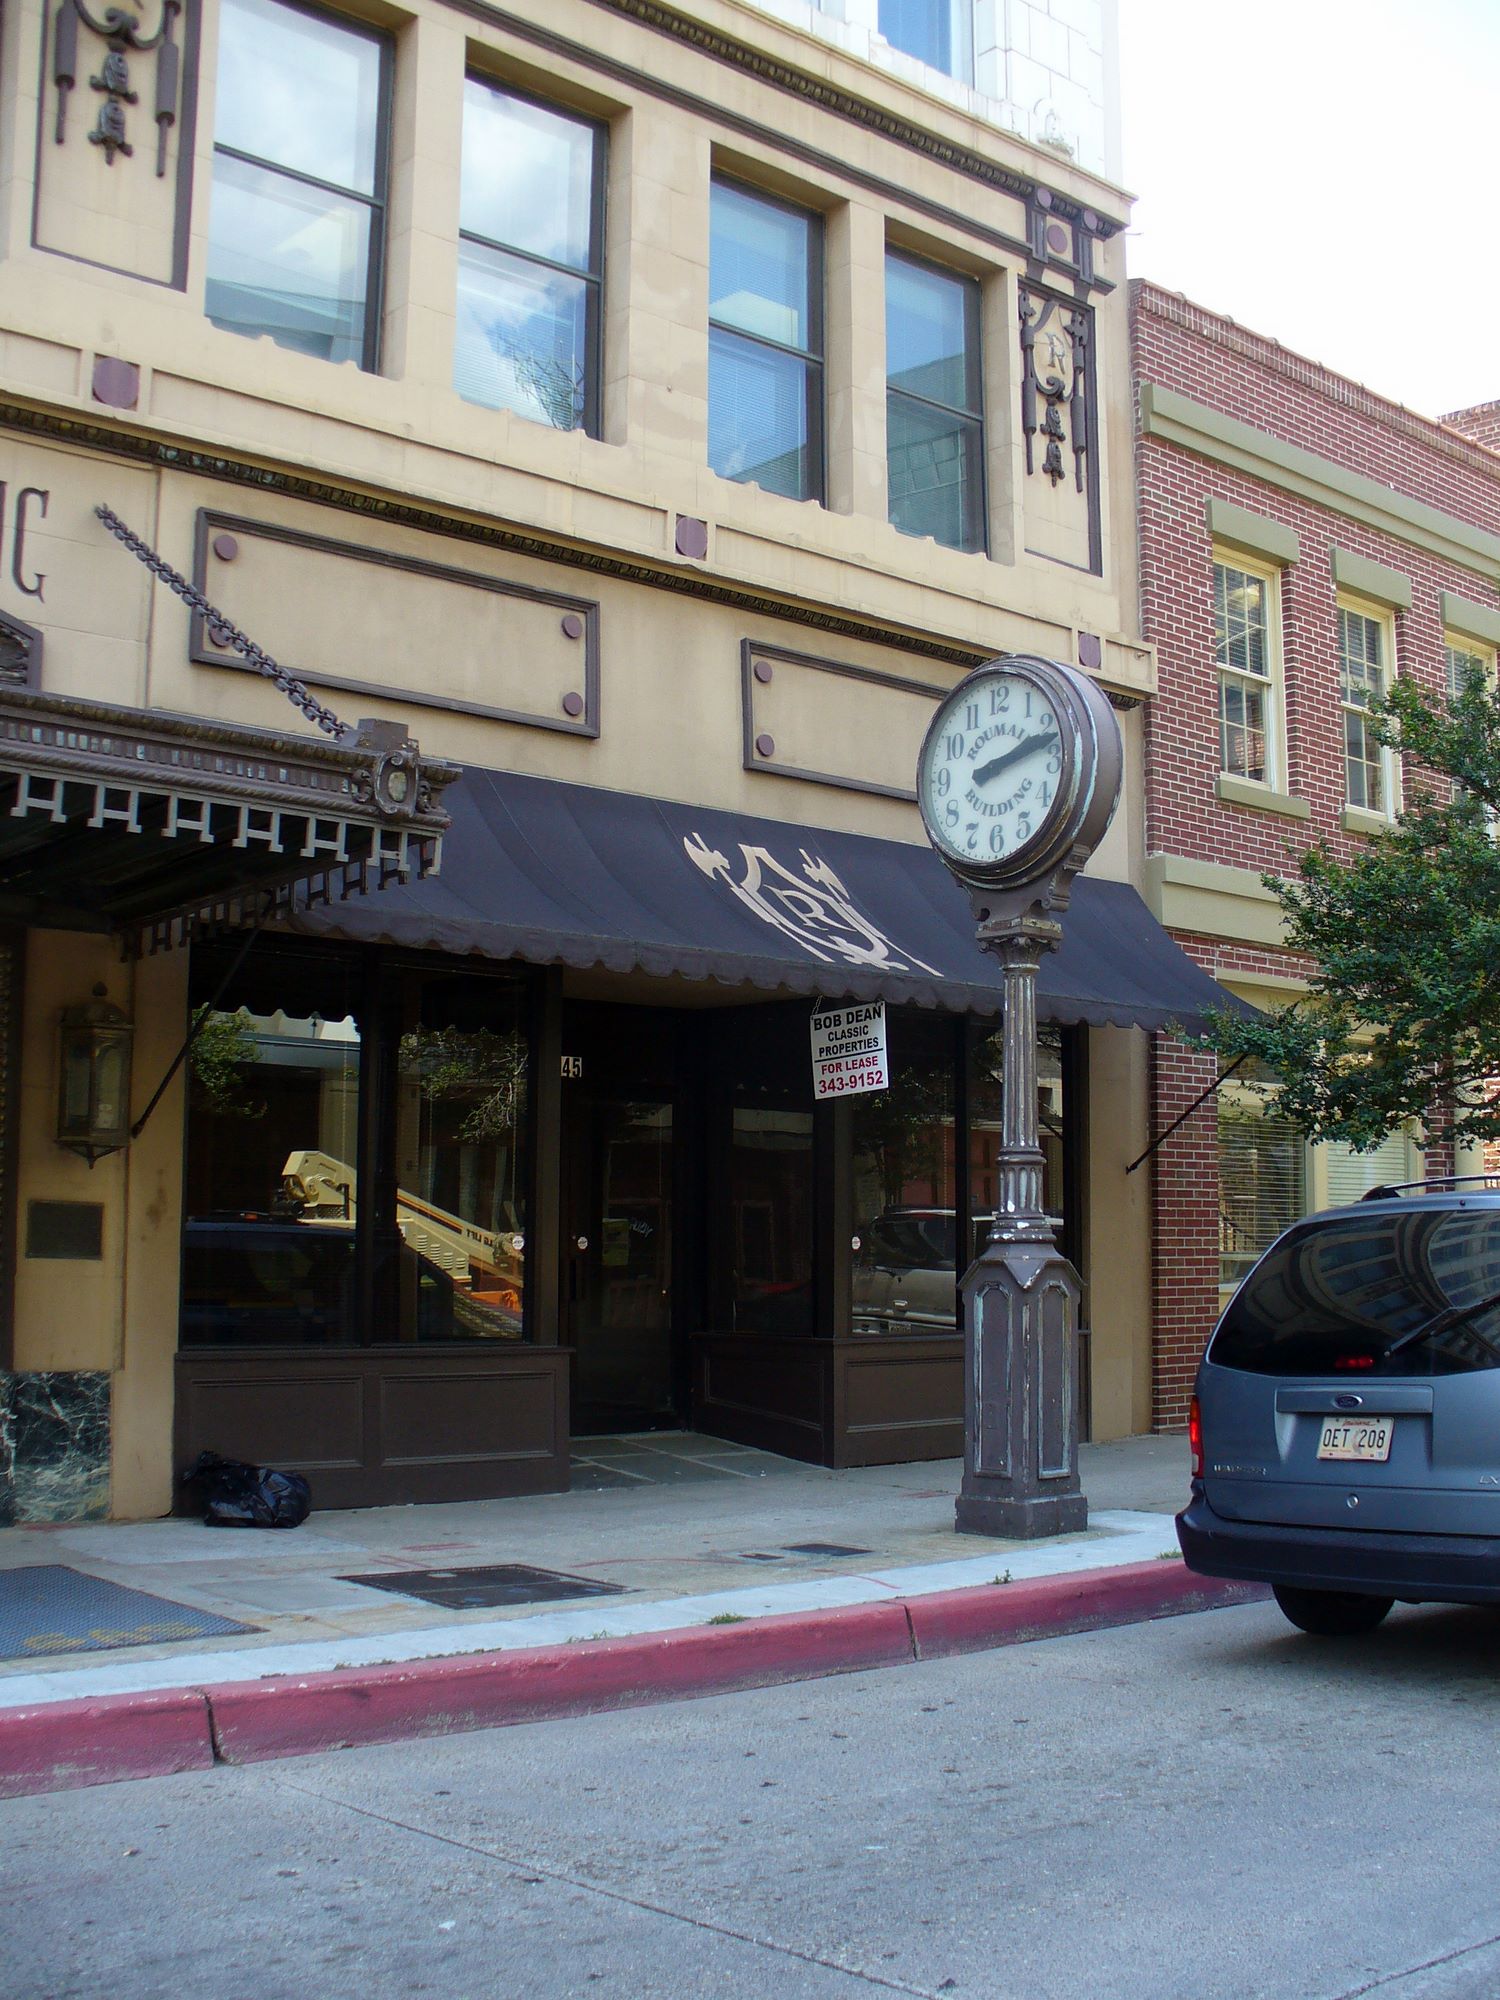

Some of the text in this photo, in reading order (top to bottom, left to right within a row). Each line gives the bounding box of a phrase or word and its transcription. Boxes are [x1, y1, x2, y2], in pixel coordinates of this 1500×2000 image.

[989, 685, 1010, 716] 12
[1023, 691, 1032, 719] 1
[965, 703, 980, 732] 11
[1040, 712, 1054, 734] 2
[944, 732, 965, 762] 10
[967, 722, 1030, 760] ROUMAI
[1046, 743, 1061, 775] 3
[937, 767, 951, 797] 9
[1035, 780, 1052, 809] 4
[965, 778, 1032, 817] BUILDING
[945, 799, 960, 828] 8
[1016, 810, 1031, 840] 5
[965, 821, 979, 851] 7
[989, 824, 1005, 854] 6
[814, 1005, 881, 1031] BOB DEAN
[818, 1037, 879, 1057] PROPERTIES
[827, 1025, 869, 1042] CLASSIC
[562, 1056, 581, 1078] 45
[821, 1056, 878, 1075] FOR LEASE
[818, 1070, 884, 1094] 343-9152
[1358, 1429, 1386, 1449] 208
